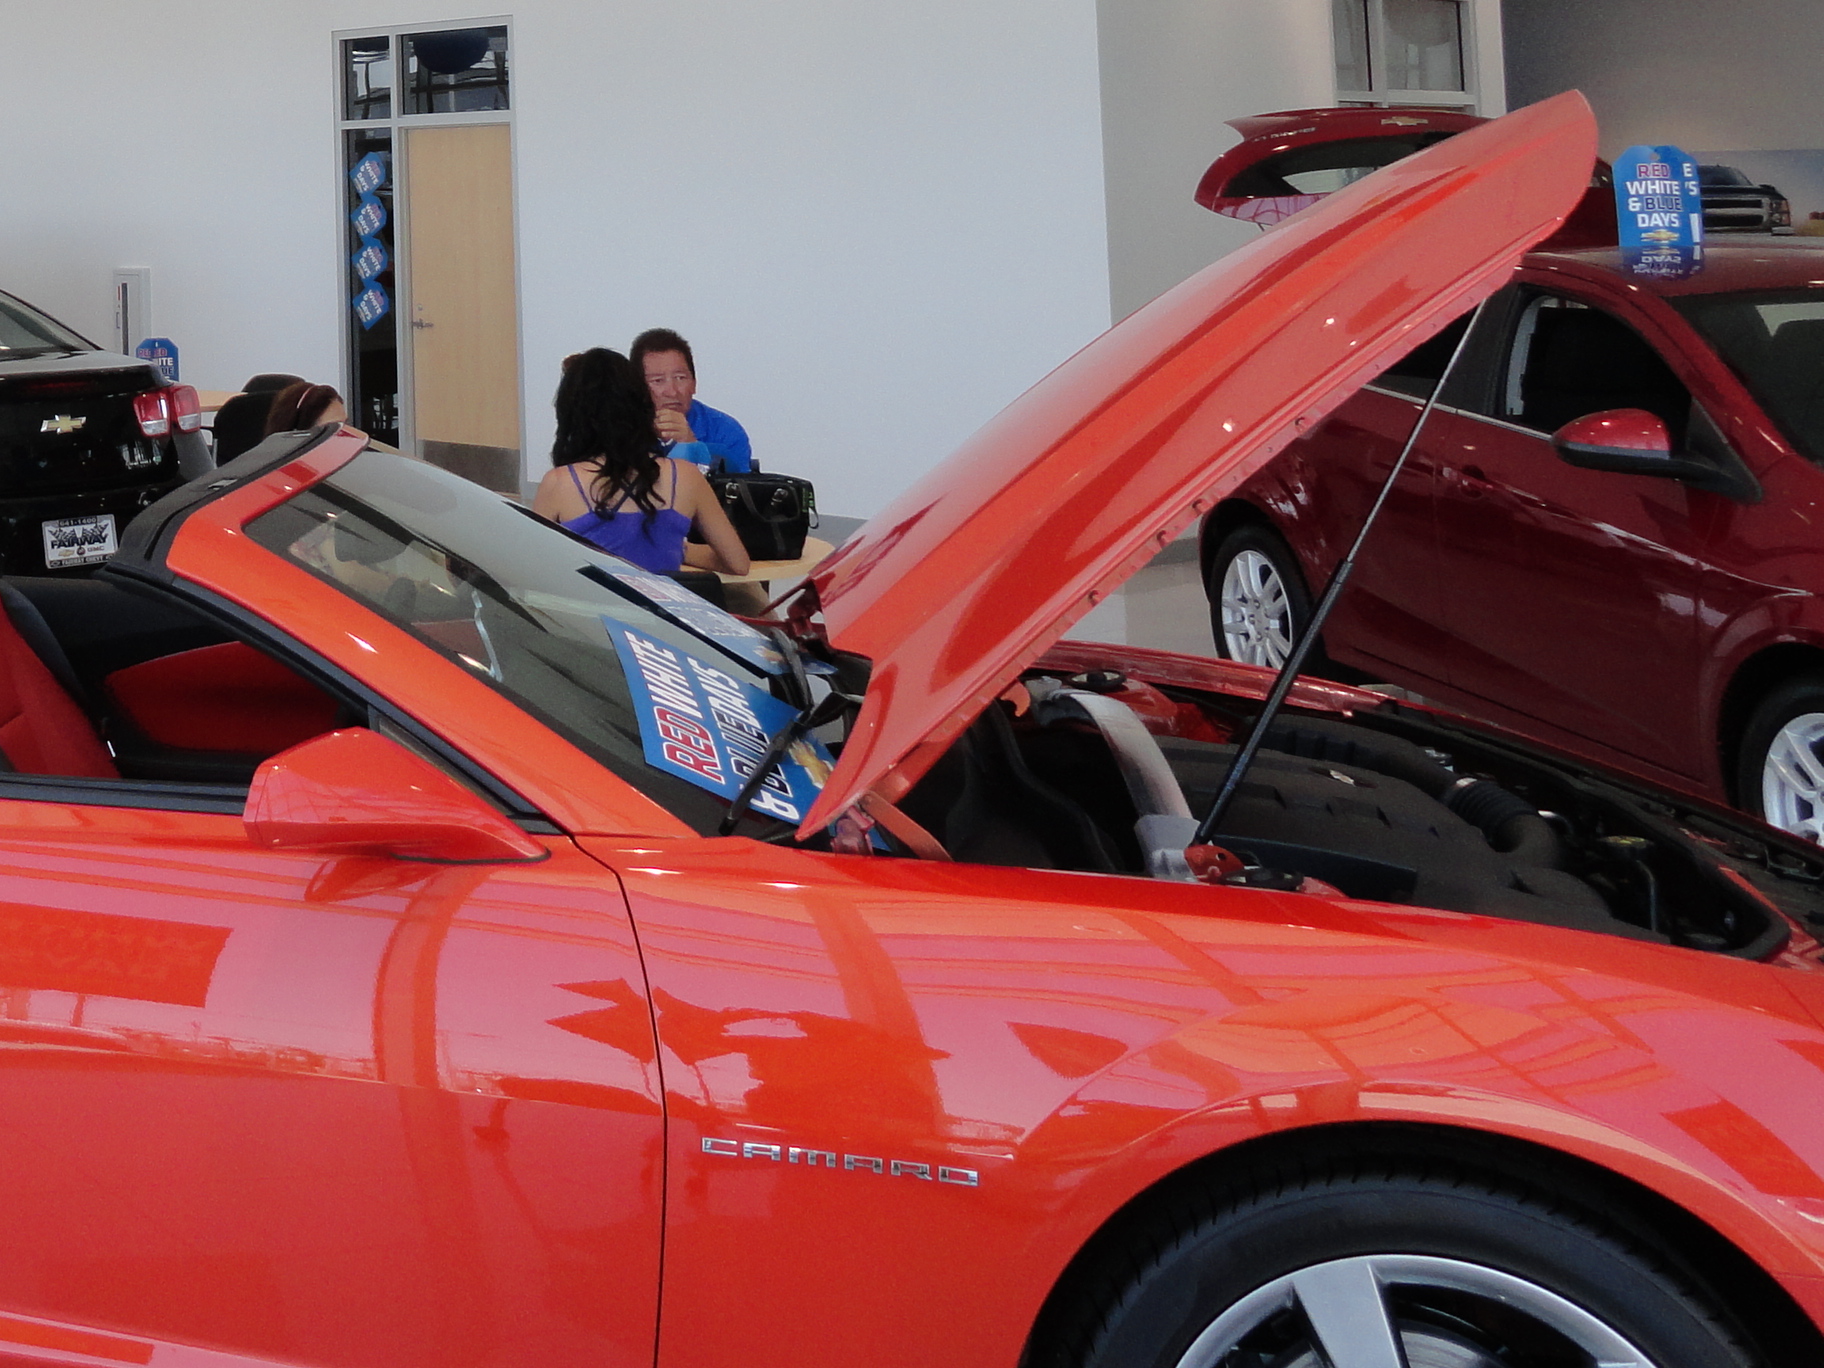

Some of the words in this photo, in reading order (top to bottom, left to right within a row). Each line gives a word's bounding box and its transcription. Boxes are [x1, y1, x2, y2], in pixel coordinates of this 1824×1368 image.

[365, 160, 379, 185] WHITE
[1637, 163, 1670, 178] RED
[356, 172, 369, 191] DAYS
[1626, 180, 1681, 195] WHITE
[1628, 197, 1642, 212] &
[1644, 196, 1683, 212] BLUE
[358, 215, 370, 234] DAYS
[366, 203, 380, 228] WHITE
[1637, 213, 1680, 227] DAYS
[359, 257, 371, 277] DAYS
[367, 246, 381, 272] WHITE
[360, 301, 372, 320] DAYS
[368, 289, 382, 315] WHITE
[137, 348, 152, 357] RE
[158, 357, 174, 366] ITE
[50, 532, 109, 549] FAIRWAY
[624, 630, 704, 720] WHITE
[687, 657, 763, 730] DAYS
[653, 705, 726, 786] RED
[711, 706, 794, 798] BLUE
[701, 1136, 979, 1187] CAMARO
